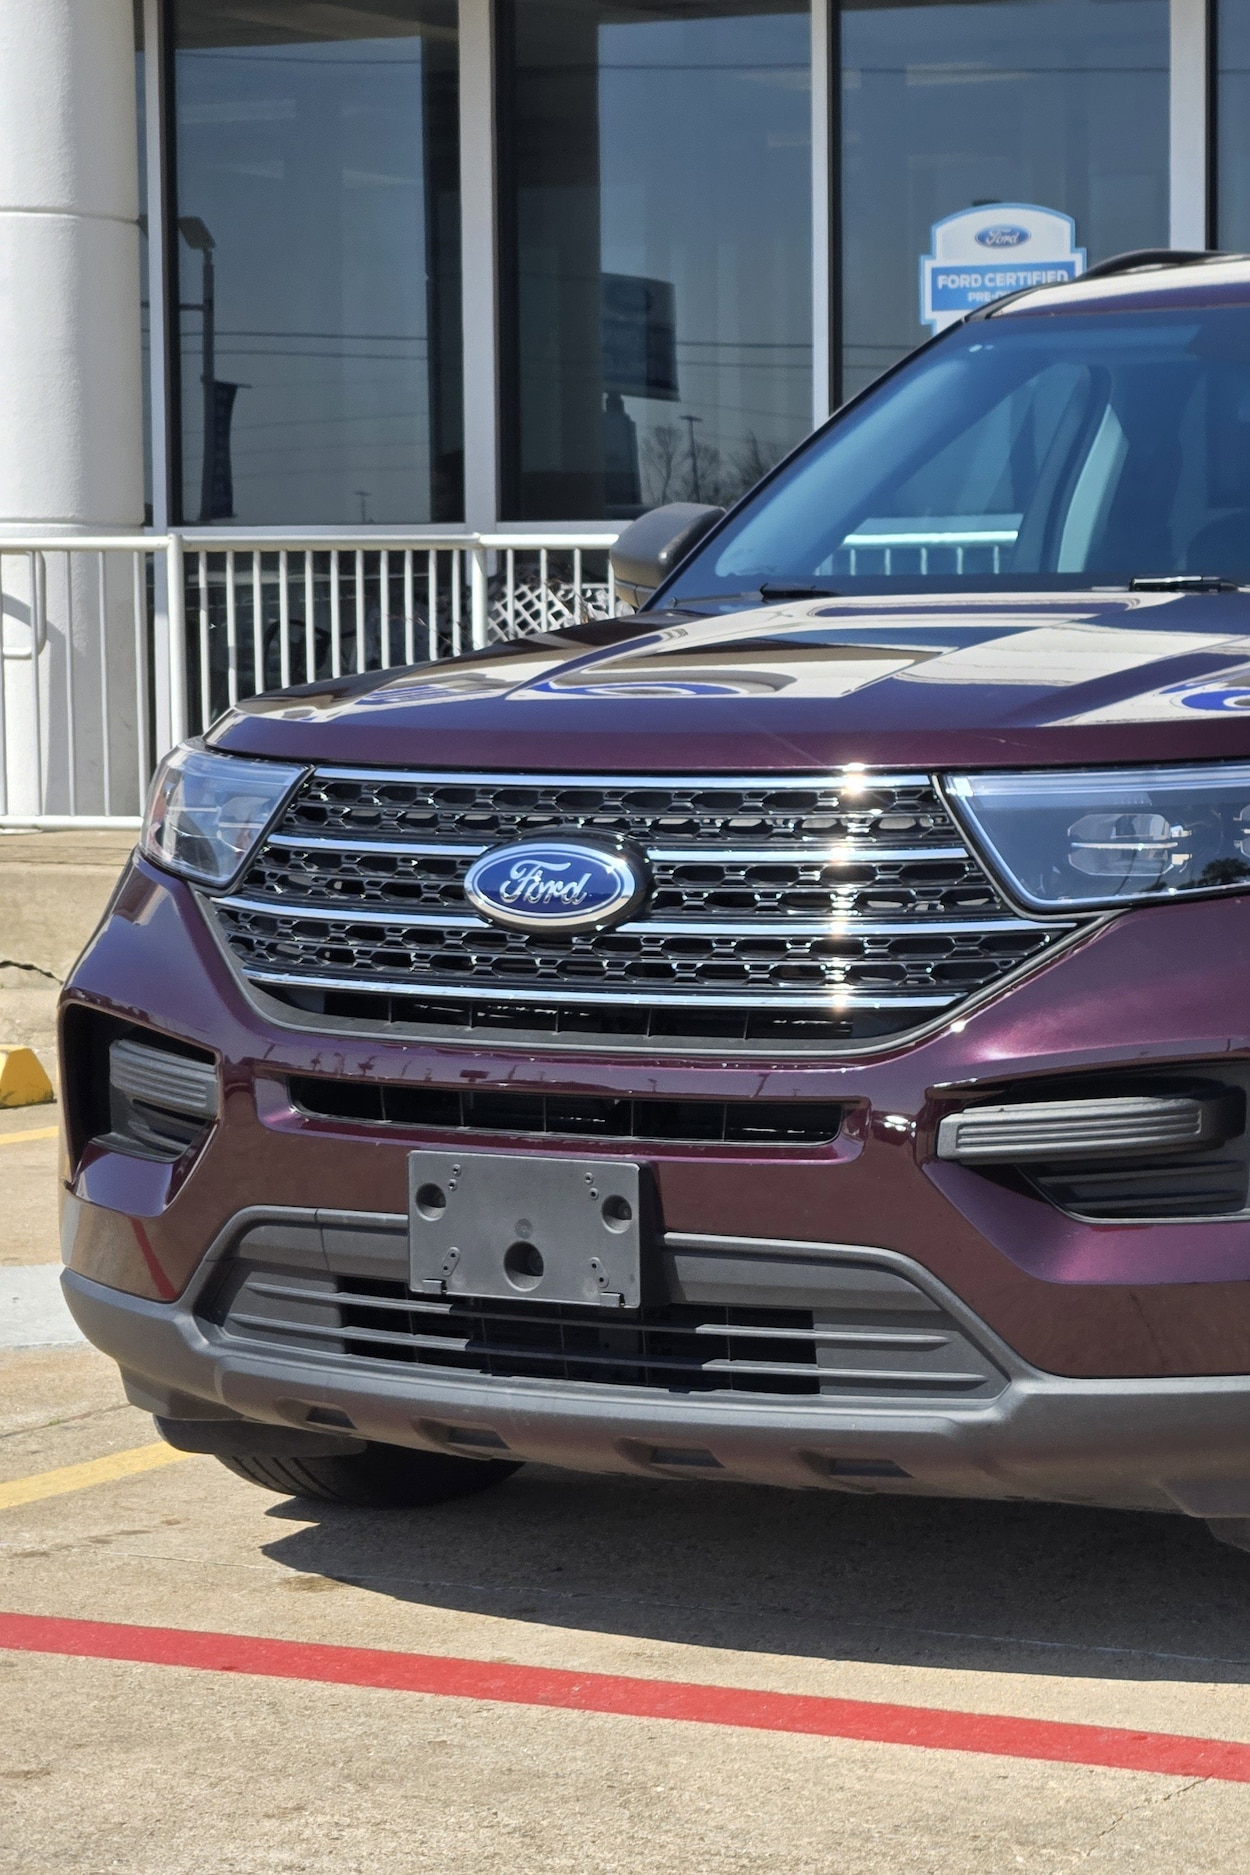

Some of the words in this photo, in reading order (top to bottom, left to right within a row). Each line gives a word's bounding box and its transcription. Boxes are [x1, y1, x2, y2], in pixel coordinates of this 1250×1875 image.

[985, 228, 1020, 245] Ford
[938, 273, 982, 289] FORD
[985, 270, 1069, 287] CERTIFIED
[500, 860, 593, 905] Ford
